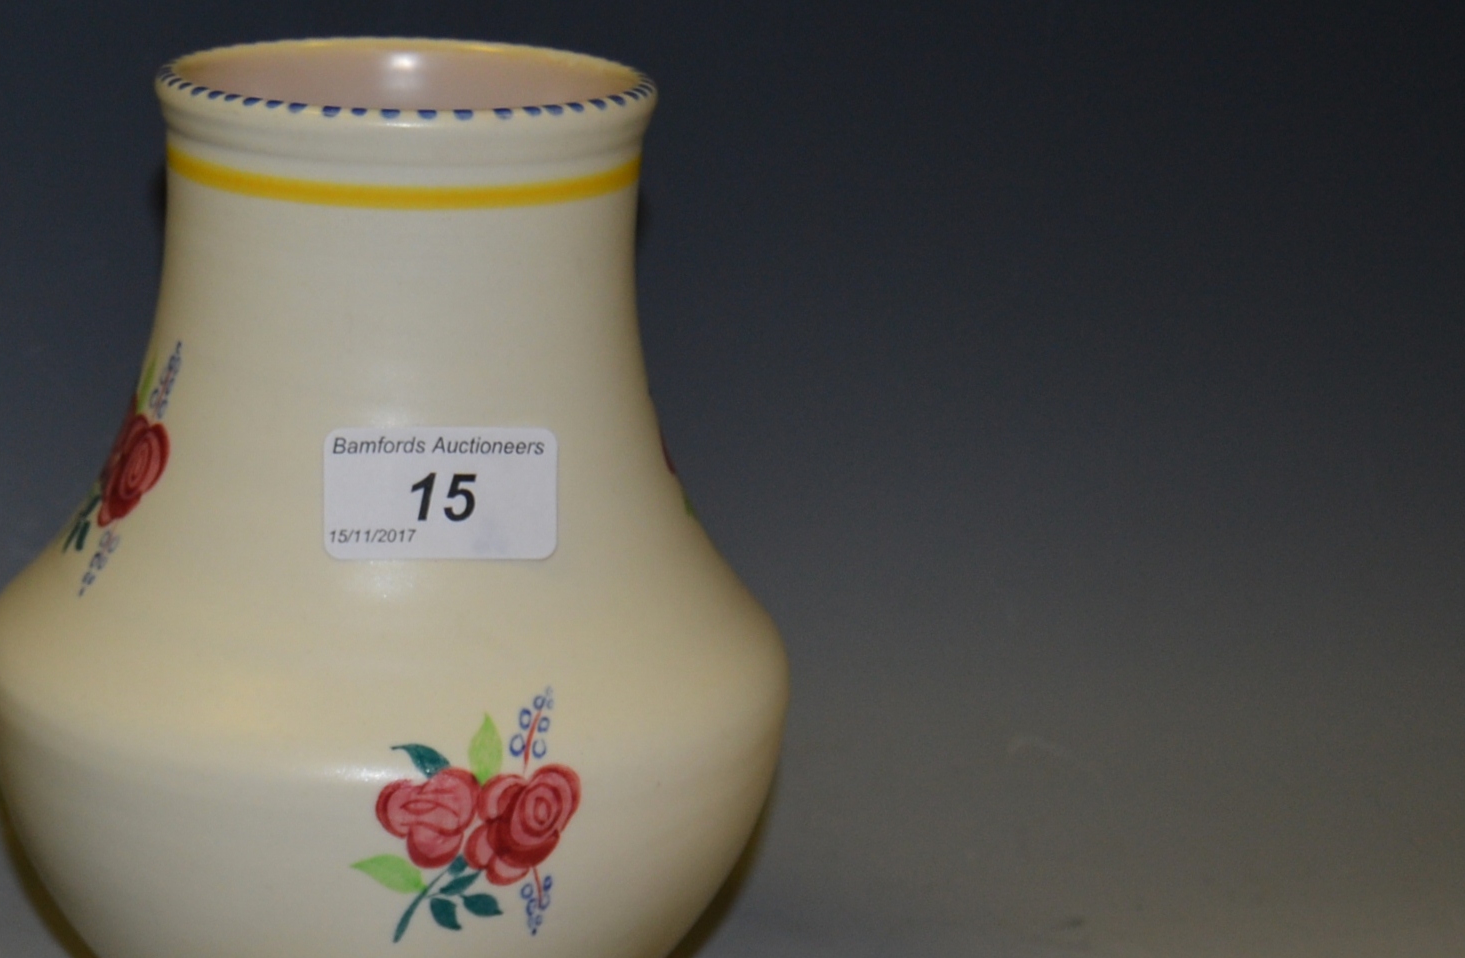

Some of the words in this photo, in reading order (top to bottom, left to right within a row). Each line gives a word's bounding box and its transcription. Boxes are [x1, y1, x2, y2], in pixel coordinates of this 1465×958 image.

[332, 436, 426, 455] Bamfords
[432, 436, 546, 456] Auctioneers
[410, 472, 477, 522] 15
[329, 529, 416, 544] 15/11/2017
